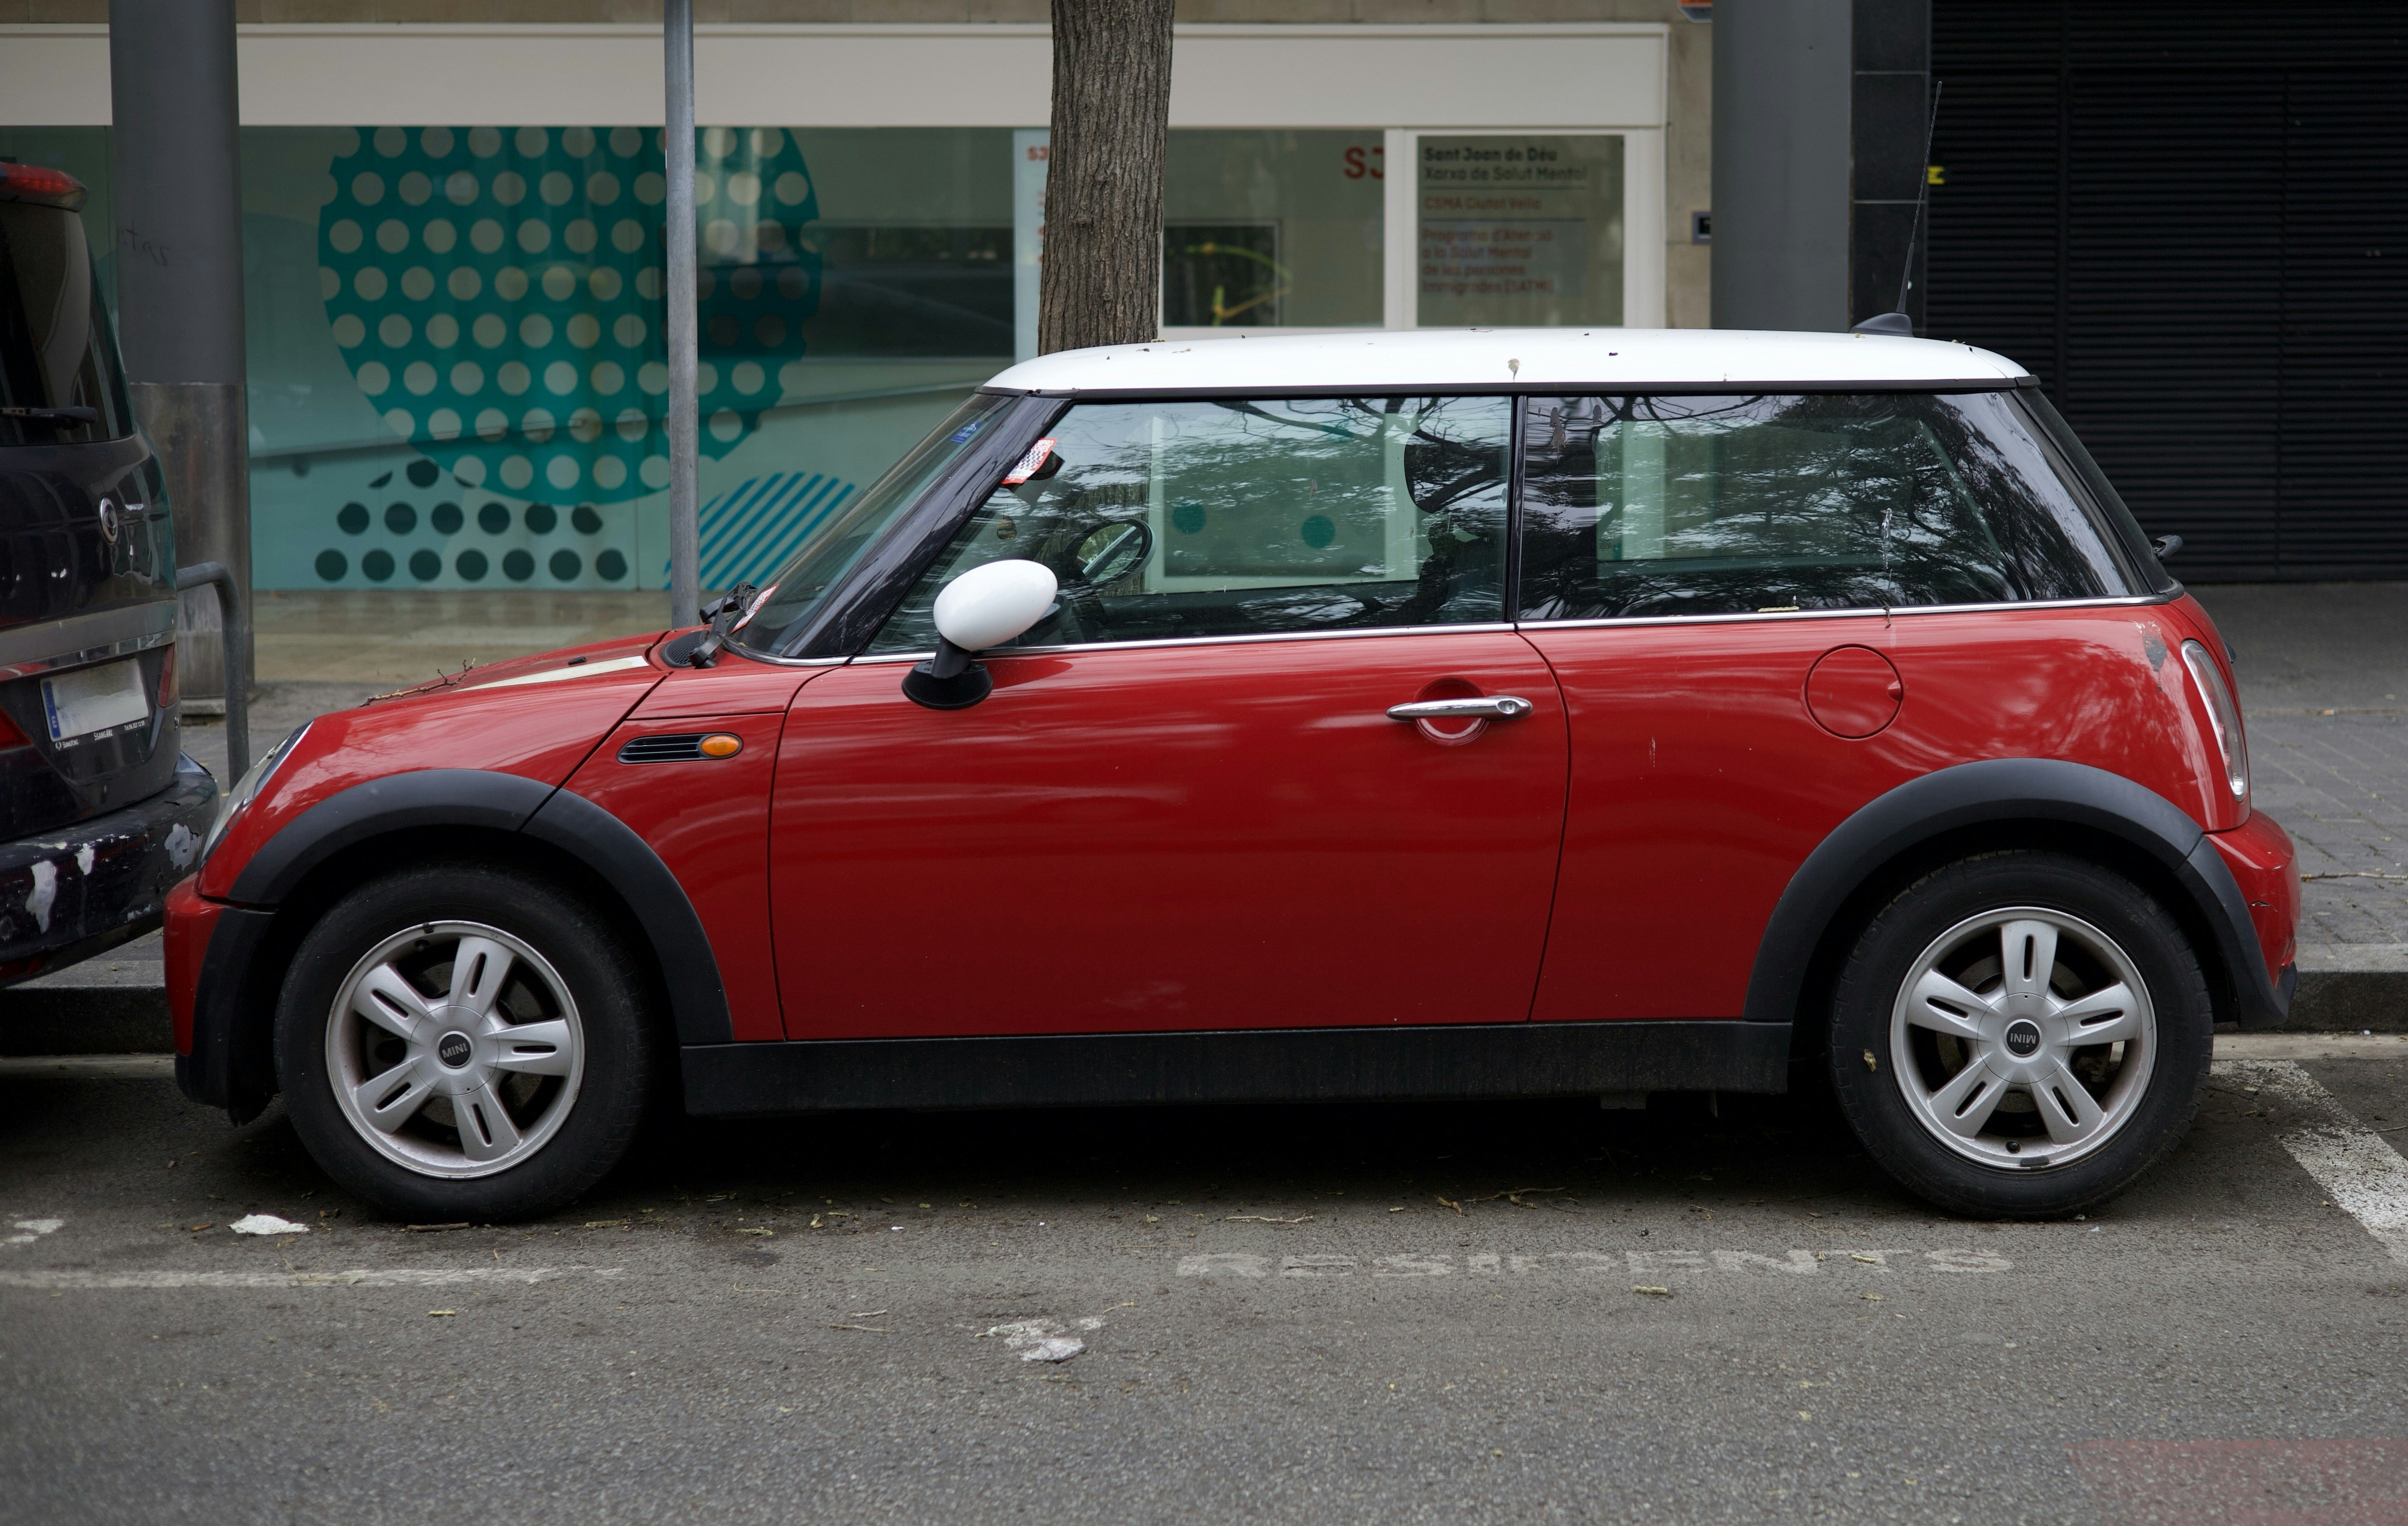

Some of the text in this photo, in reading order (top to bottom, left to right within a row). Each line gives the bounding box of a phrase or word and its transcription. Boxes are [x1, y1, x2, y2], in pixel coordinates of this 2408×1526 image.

[1424, 147, 1460, 161] Sant
[1463, 147, 1501, 161] Joan
[1505, 147, 1522, 161] de
[1471, 166, 1488, 180] de
[51, 716, 57, 728] E
[2010, 1033, 2036, 1044] MINI
[442, 1042, 467, 1059] MINI
